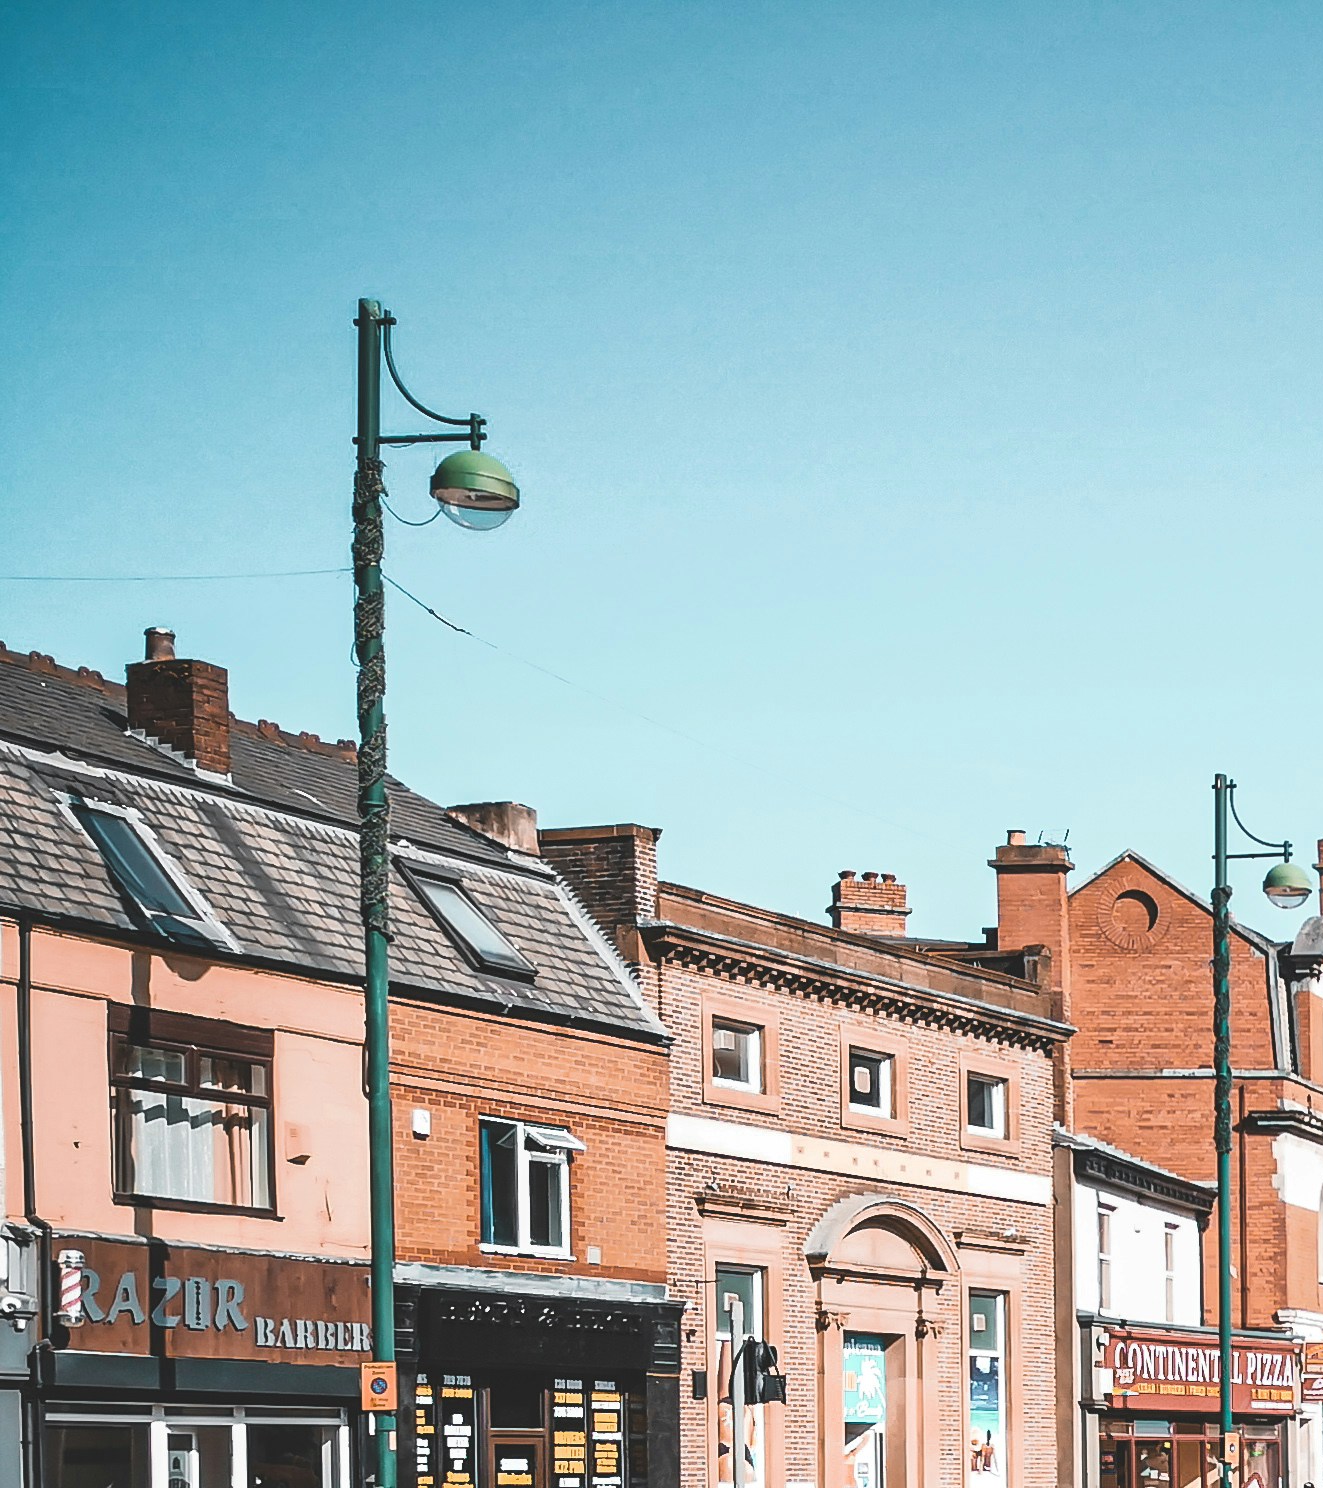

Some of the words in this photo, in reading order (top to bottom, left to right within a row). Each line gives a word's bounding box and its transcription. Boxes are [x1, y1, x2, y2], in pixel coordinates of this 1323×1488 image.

[81, 1269, 249, 1331] RAZOR
[1115, 1342, 1242, 1385] CONTINENTL
[1246, 1353, 1294, 1387] PIZZA
